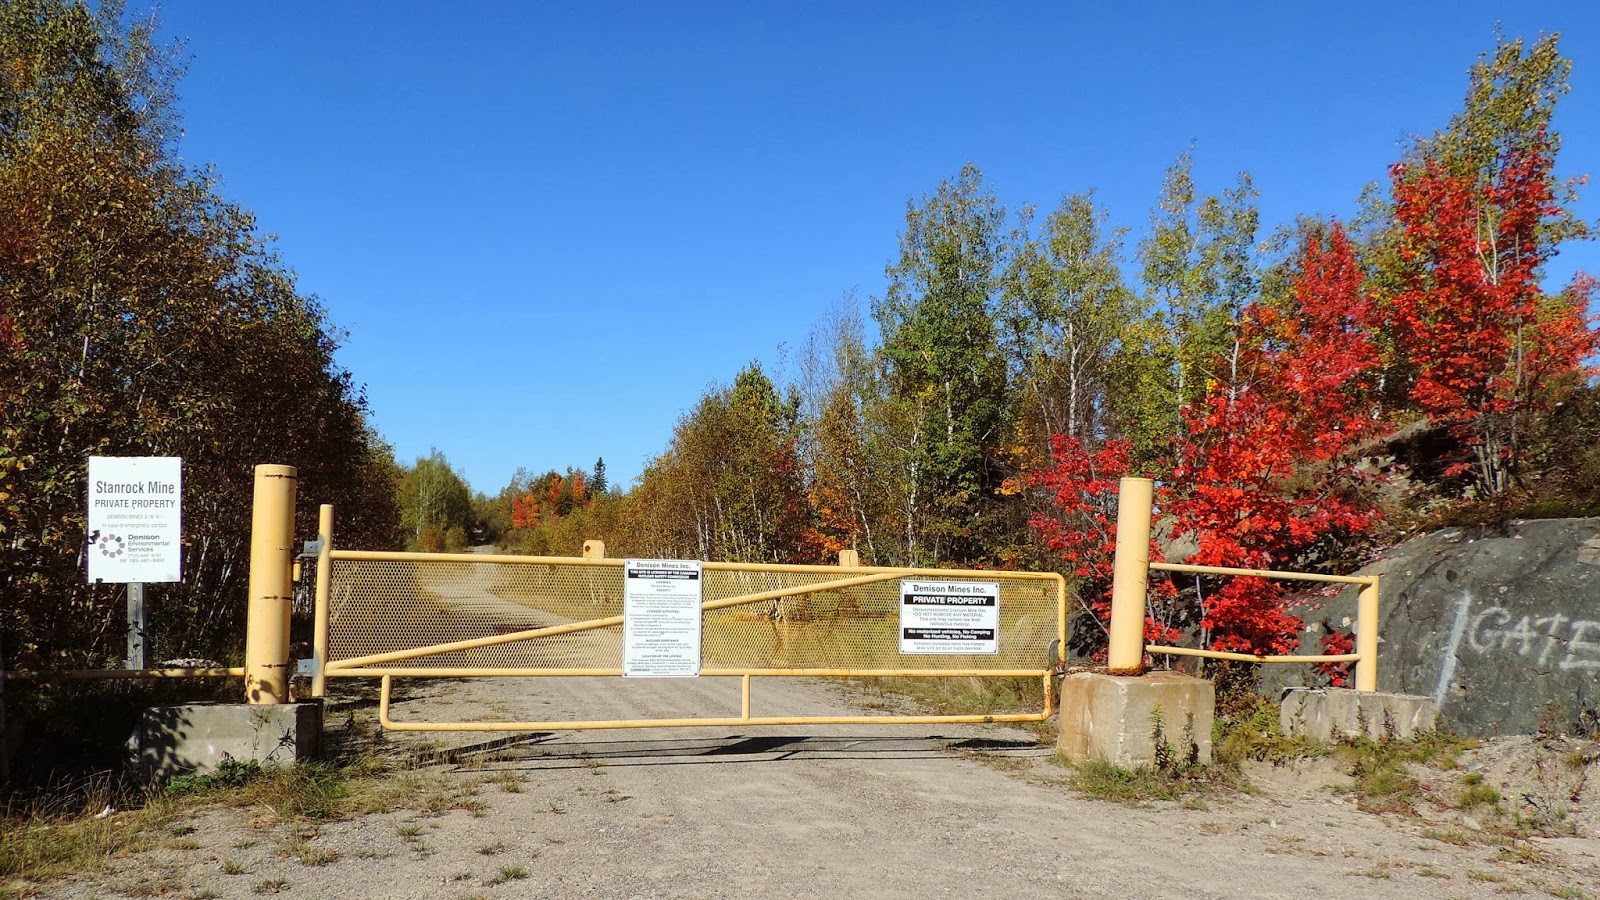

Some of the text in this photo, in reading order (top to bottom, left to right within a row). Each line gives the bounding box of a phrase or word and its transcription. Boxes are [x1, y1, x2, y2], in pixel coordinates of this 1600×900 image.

[96, 481, 174, 494] Stanrock Mine
[95, 500, 175, 508] PRIVATE PROPERTY
[913, 585, 945, 593] Denison
